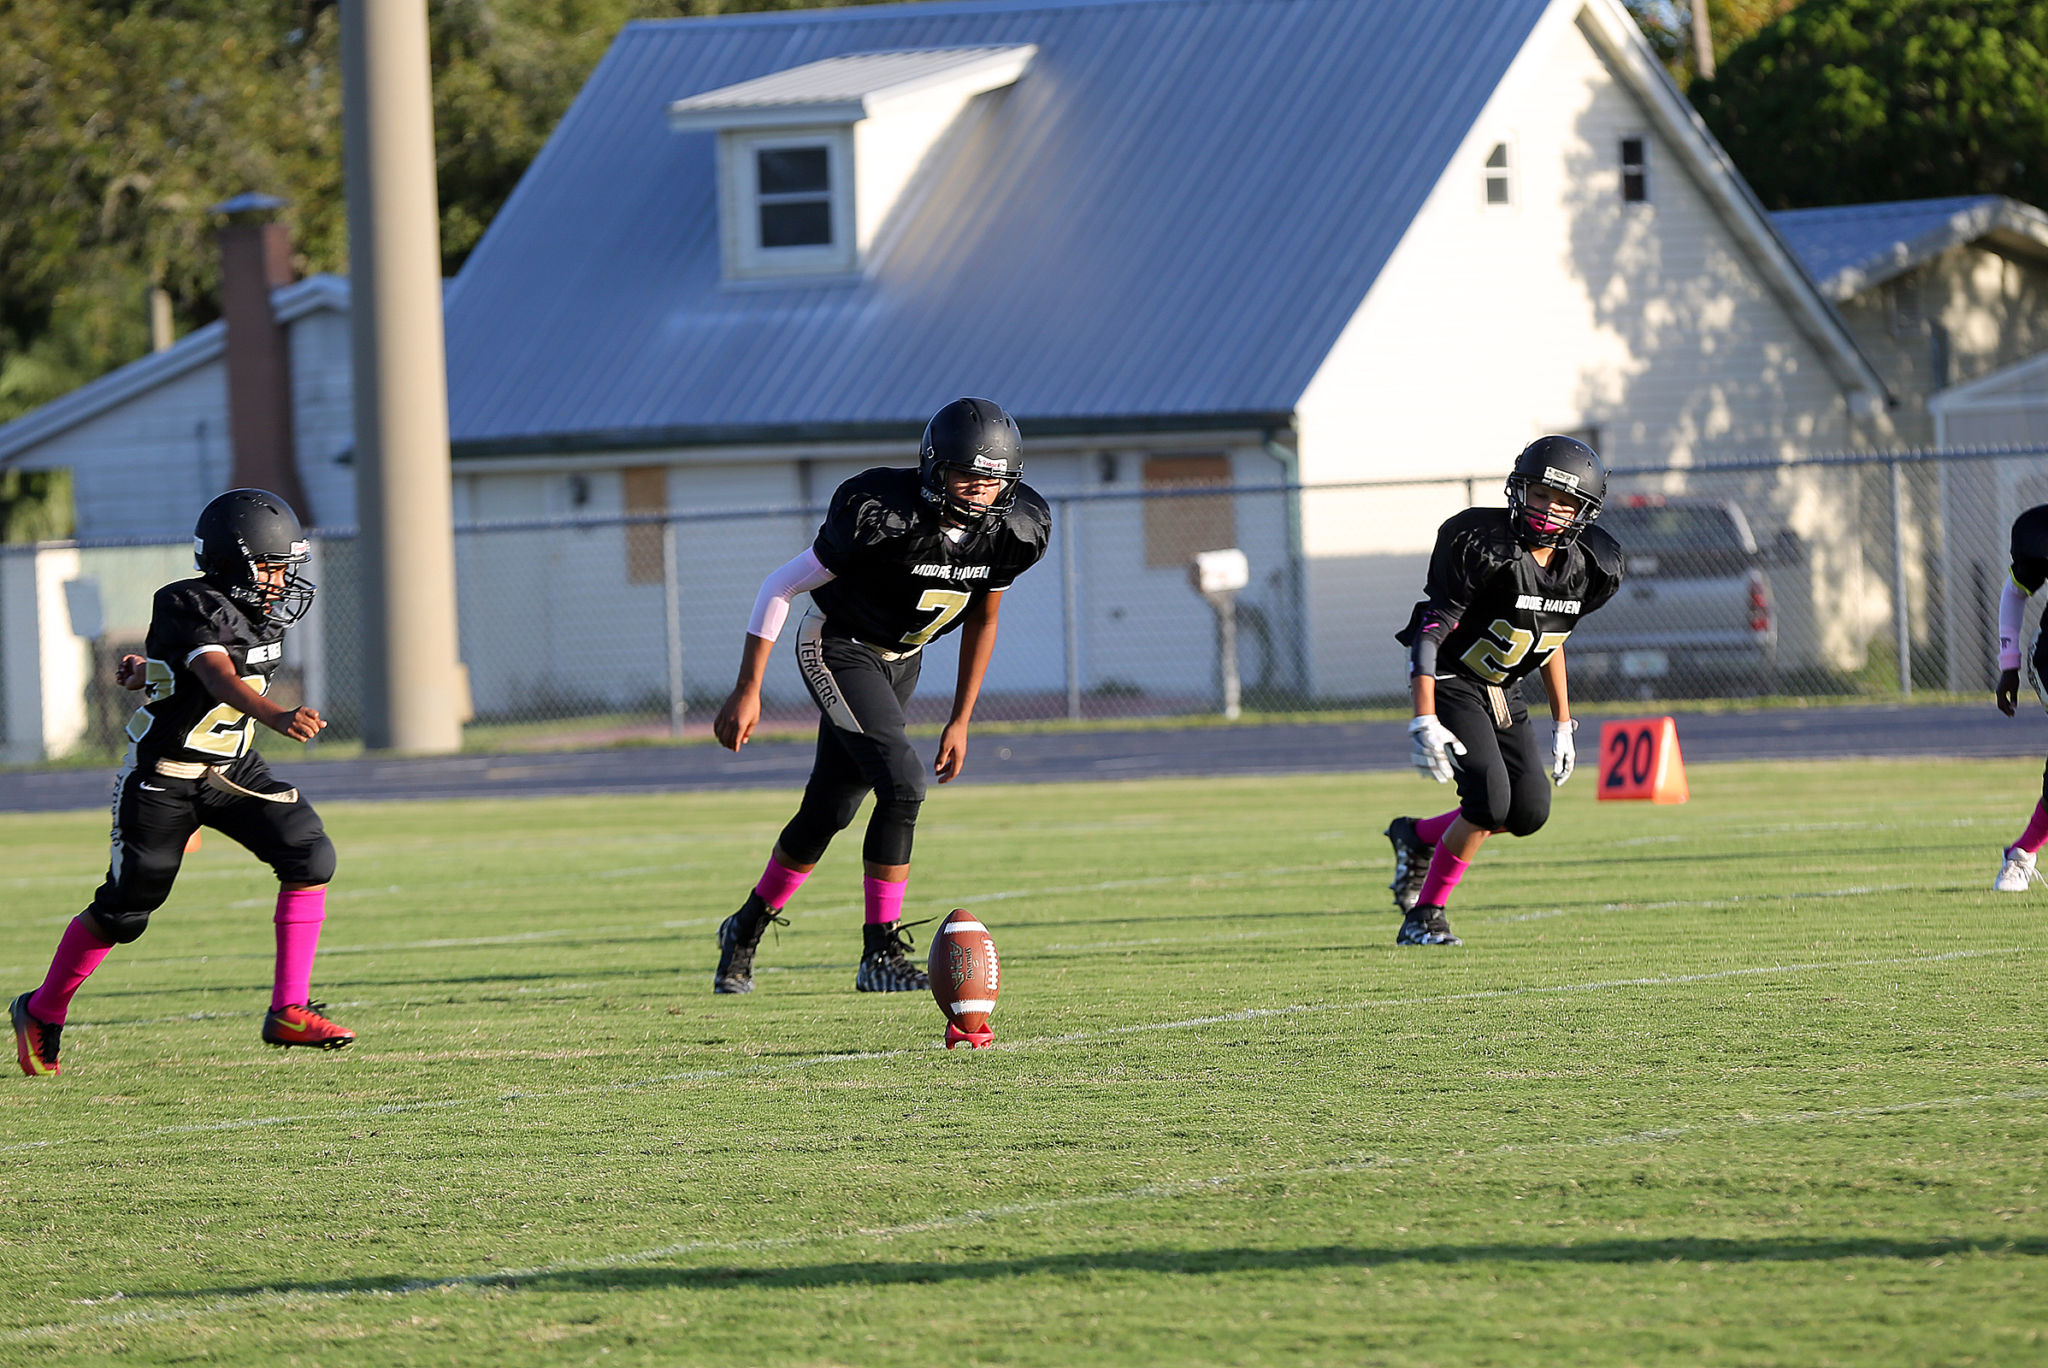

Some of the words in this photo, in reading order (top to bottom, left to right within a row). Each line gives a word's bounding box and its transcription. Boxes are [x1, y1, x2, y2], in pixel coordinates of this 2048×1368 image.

[911, 564, 952, 579] MOORE
[952, 566, 991, 580] HAVEN
[900, 589, 971, 645] 7
[1543, 599, 1581, 614] HAVEN
[801, 640, 837, 708] TERRIERS
[1460, 619, 1571, 683] 27
[1606, 731, 1653, 787] 20
